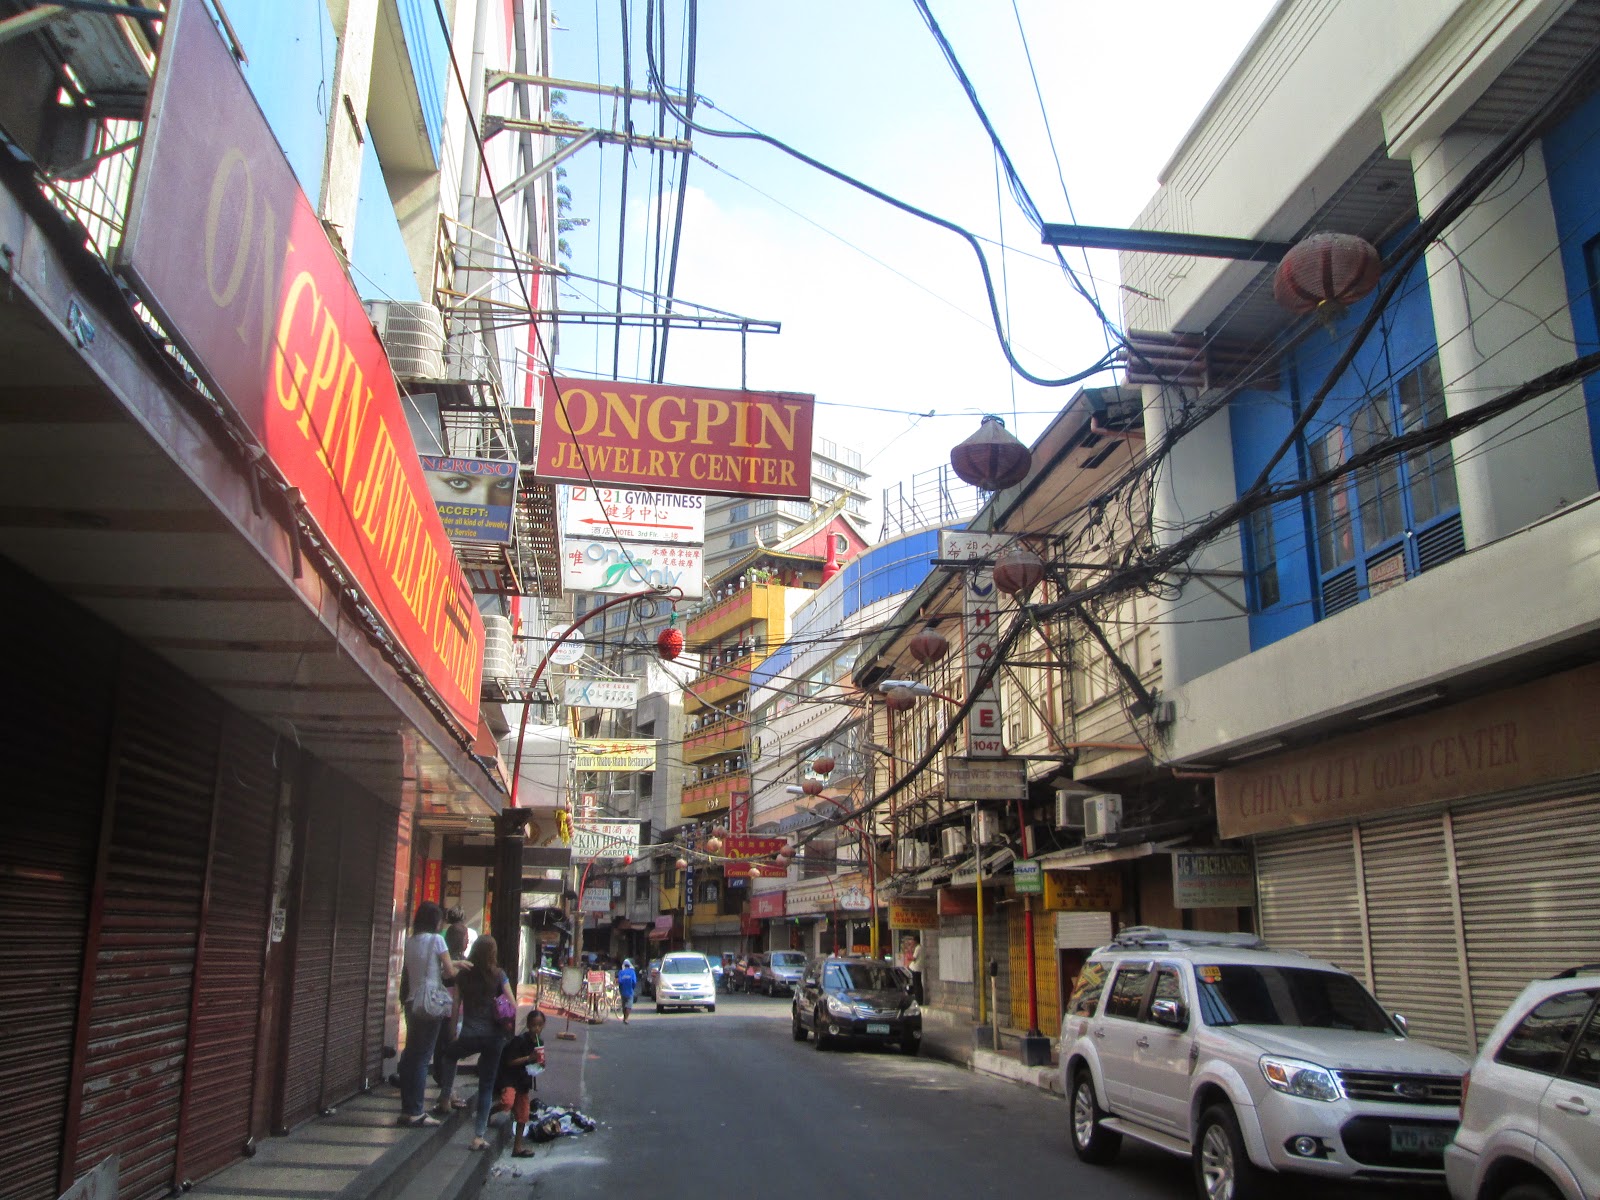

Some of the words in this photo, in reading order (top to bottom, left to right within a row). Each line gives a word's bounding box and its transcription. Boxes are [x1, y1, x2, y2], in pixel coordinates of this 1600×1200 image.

[205, 147, 375, 479] ONGPIN
[353, 413, 445, 634] JEWELRY
[432, 566, 478, 708] CENTER
[554, 388, 801, 450] ONGPIN
[551, 441, 686, 478] JEWELRY
[690, 453, 798, 487] CENTER
[594, 488, 621, 503] 121
[625, 491, 653, 505] GYM
[654, 493, 702, 509] FITNESS
[438, 505, 489, 517] ACCEPT:
[604, 504, 669, 521] 健身中心
[455, 527, 477, 537] Service
[464, 517, 477, 527] kind
[485, 520, 509, 530] Jewelry
[615, 528, 634, 537] HOTEL
[569, 550, 583, 574] 唯一
[587, 543, 634, 563] One
[628, 562, 682, 586] Only
[973, 740, 1000, 751] 1047
[1239, 774, 1302, 819] CHINA
[1309, 758, 1362, 807] CITY
[1372, 743, 1425, 792] GOLD
[1429, 720, 1520, 781] CENTER
[578, 834, 600, 849] KIM
[603, 849, 631, 857] GARDE
